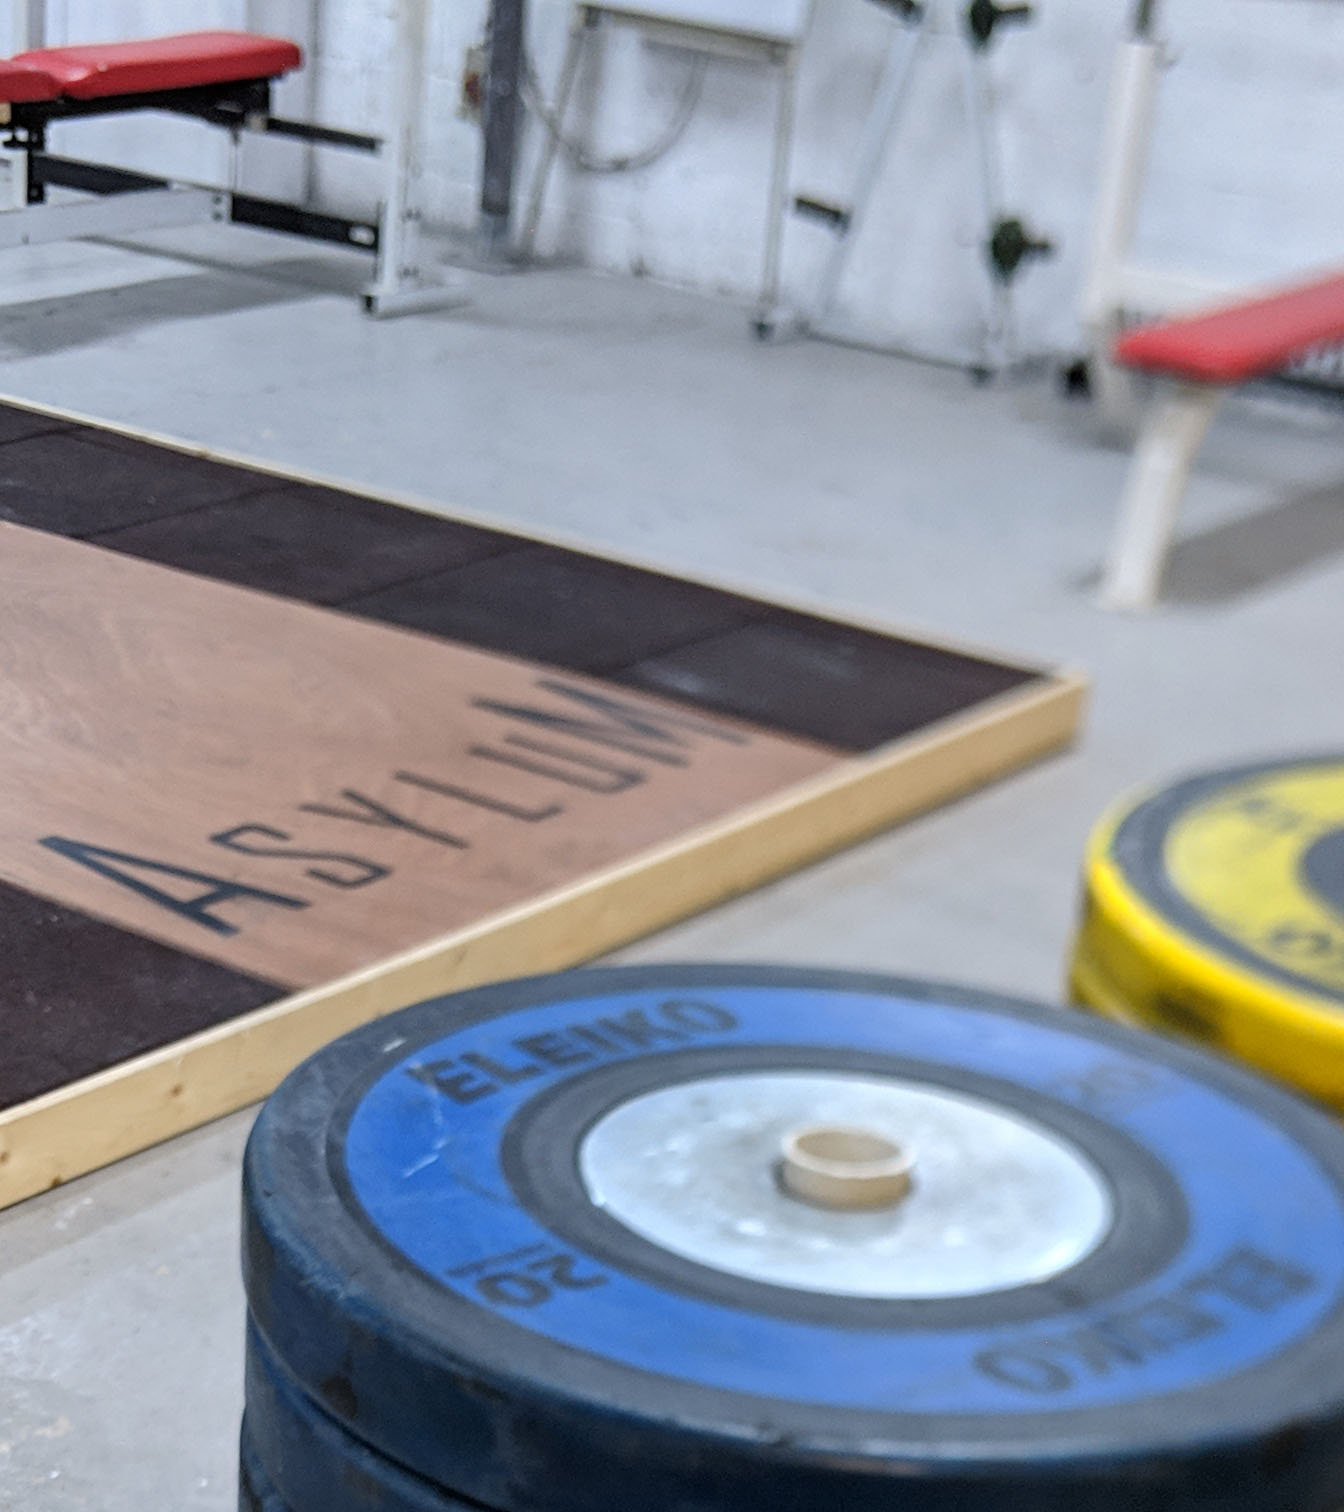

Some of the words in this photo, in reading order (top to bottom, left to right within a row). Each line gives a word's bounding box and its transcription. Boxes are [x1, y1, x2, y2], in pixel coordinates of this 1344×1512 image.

[39, 680, 752, 937] ASYLUM
[406, 999, 739, 1105] ELEIKO
[476, 1254, 610, 1308] 20
